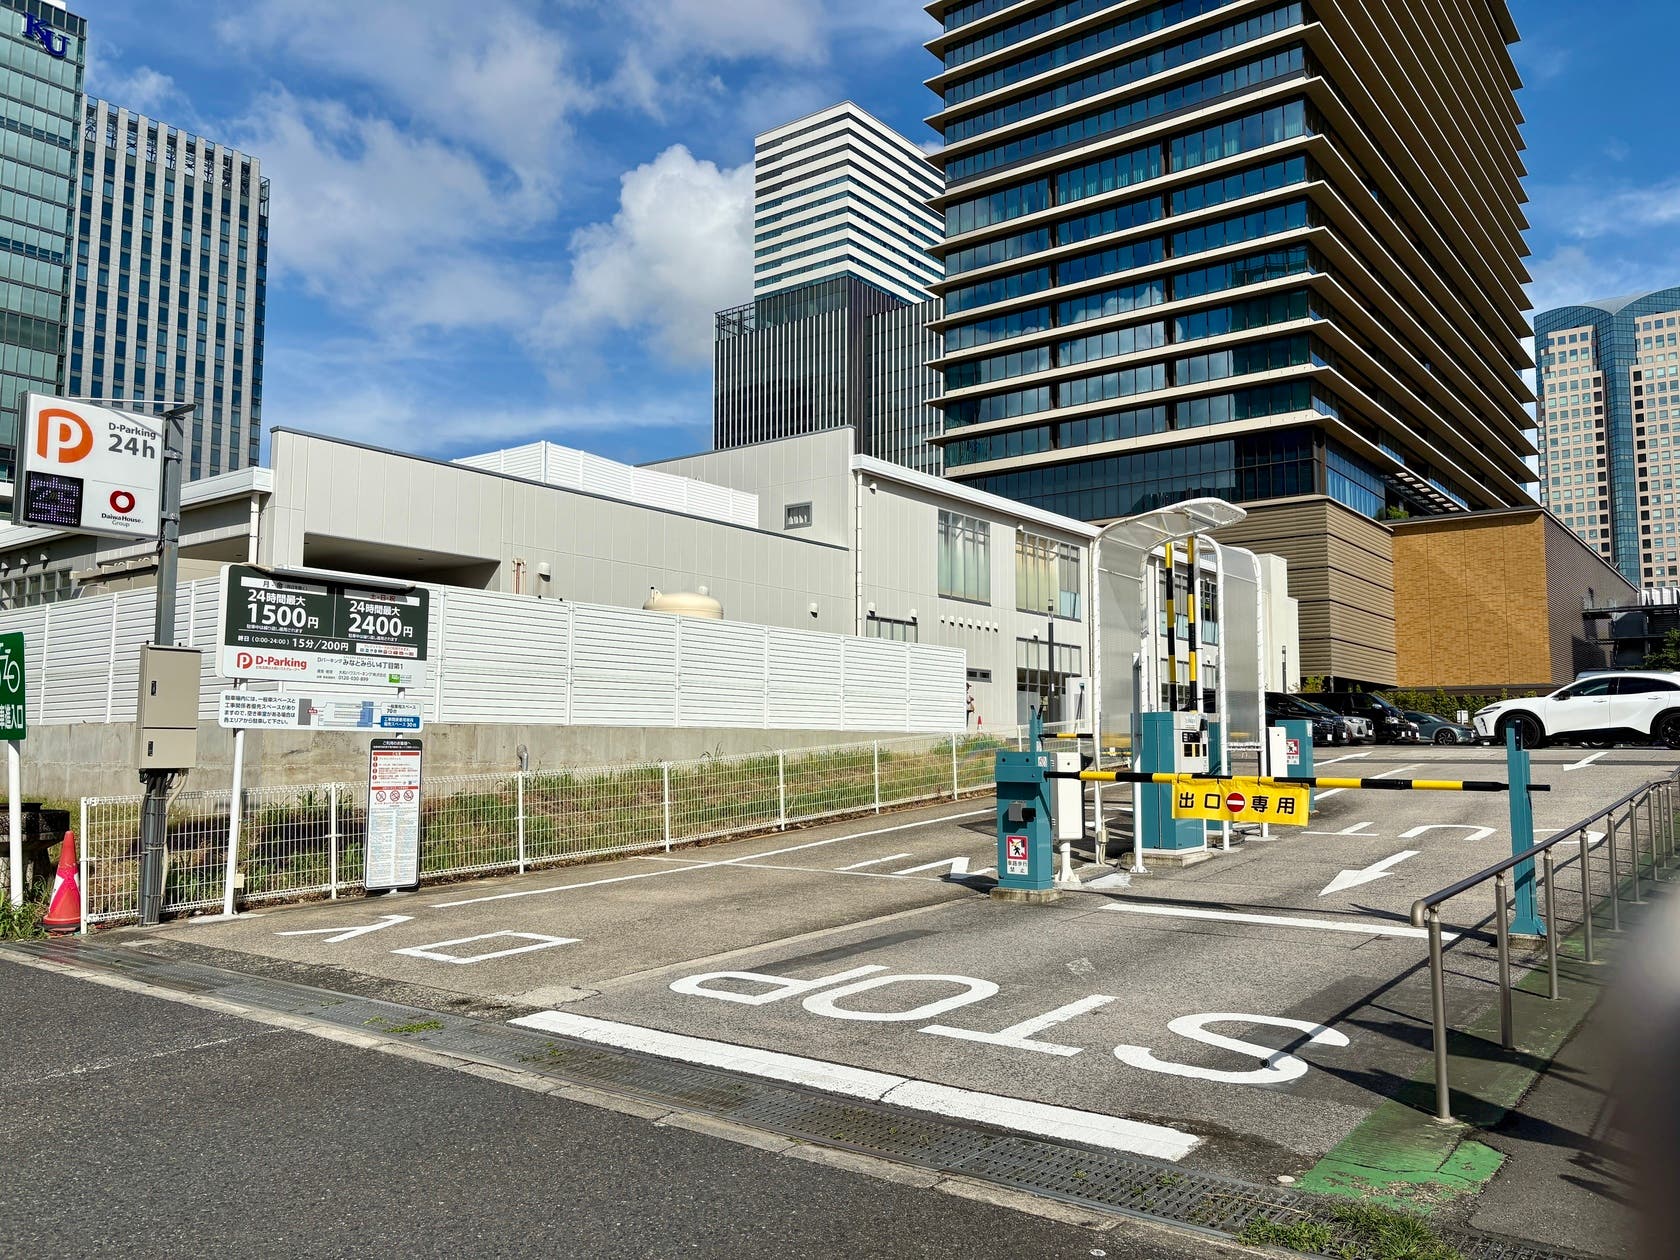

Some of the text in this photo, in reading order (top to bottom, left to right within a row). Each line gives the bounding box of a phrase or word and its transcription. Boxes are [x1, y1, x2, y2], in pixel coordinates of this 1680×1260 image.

[22, 11, 71, 60] KU
[108, 422, 157, 441] D-Parking
[108, 433, 155, 459] 24h
[29, 477, 79, 524] 空
[112, 520, 130, 528] Group
[247, 589, 306, 607] 24時間最大
[349, 600, 400, 617] 24時間最大
[247, 603, 319, 629] 1500円
[348, 613, 413, 638] 2400円
[255, 655, 307, 670] D-Parking
[1179, 791, 1295, 815] 出口 専用
[274, 914, 584, 965] 入口
[669, 964, 1350, 1085] STOP
